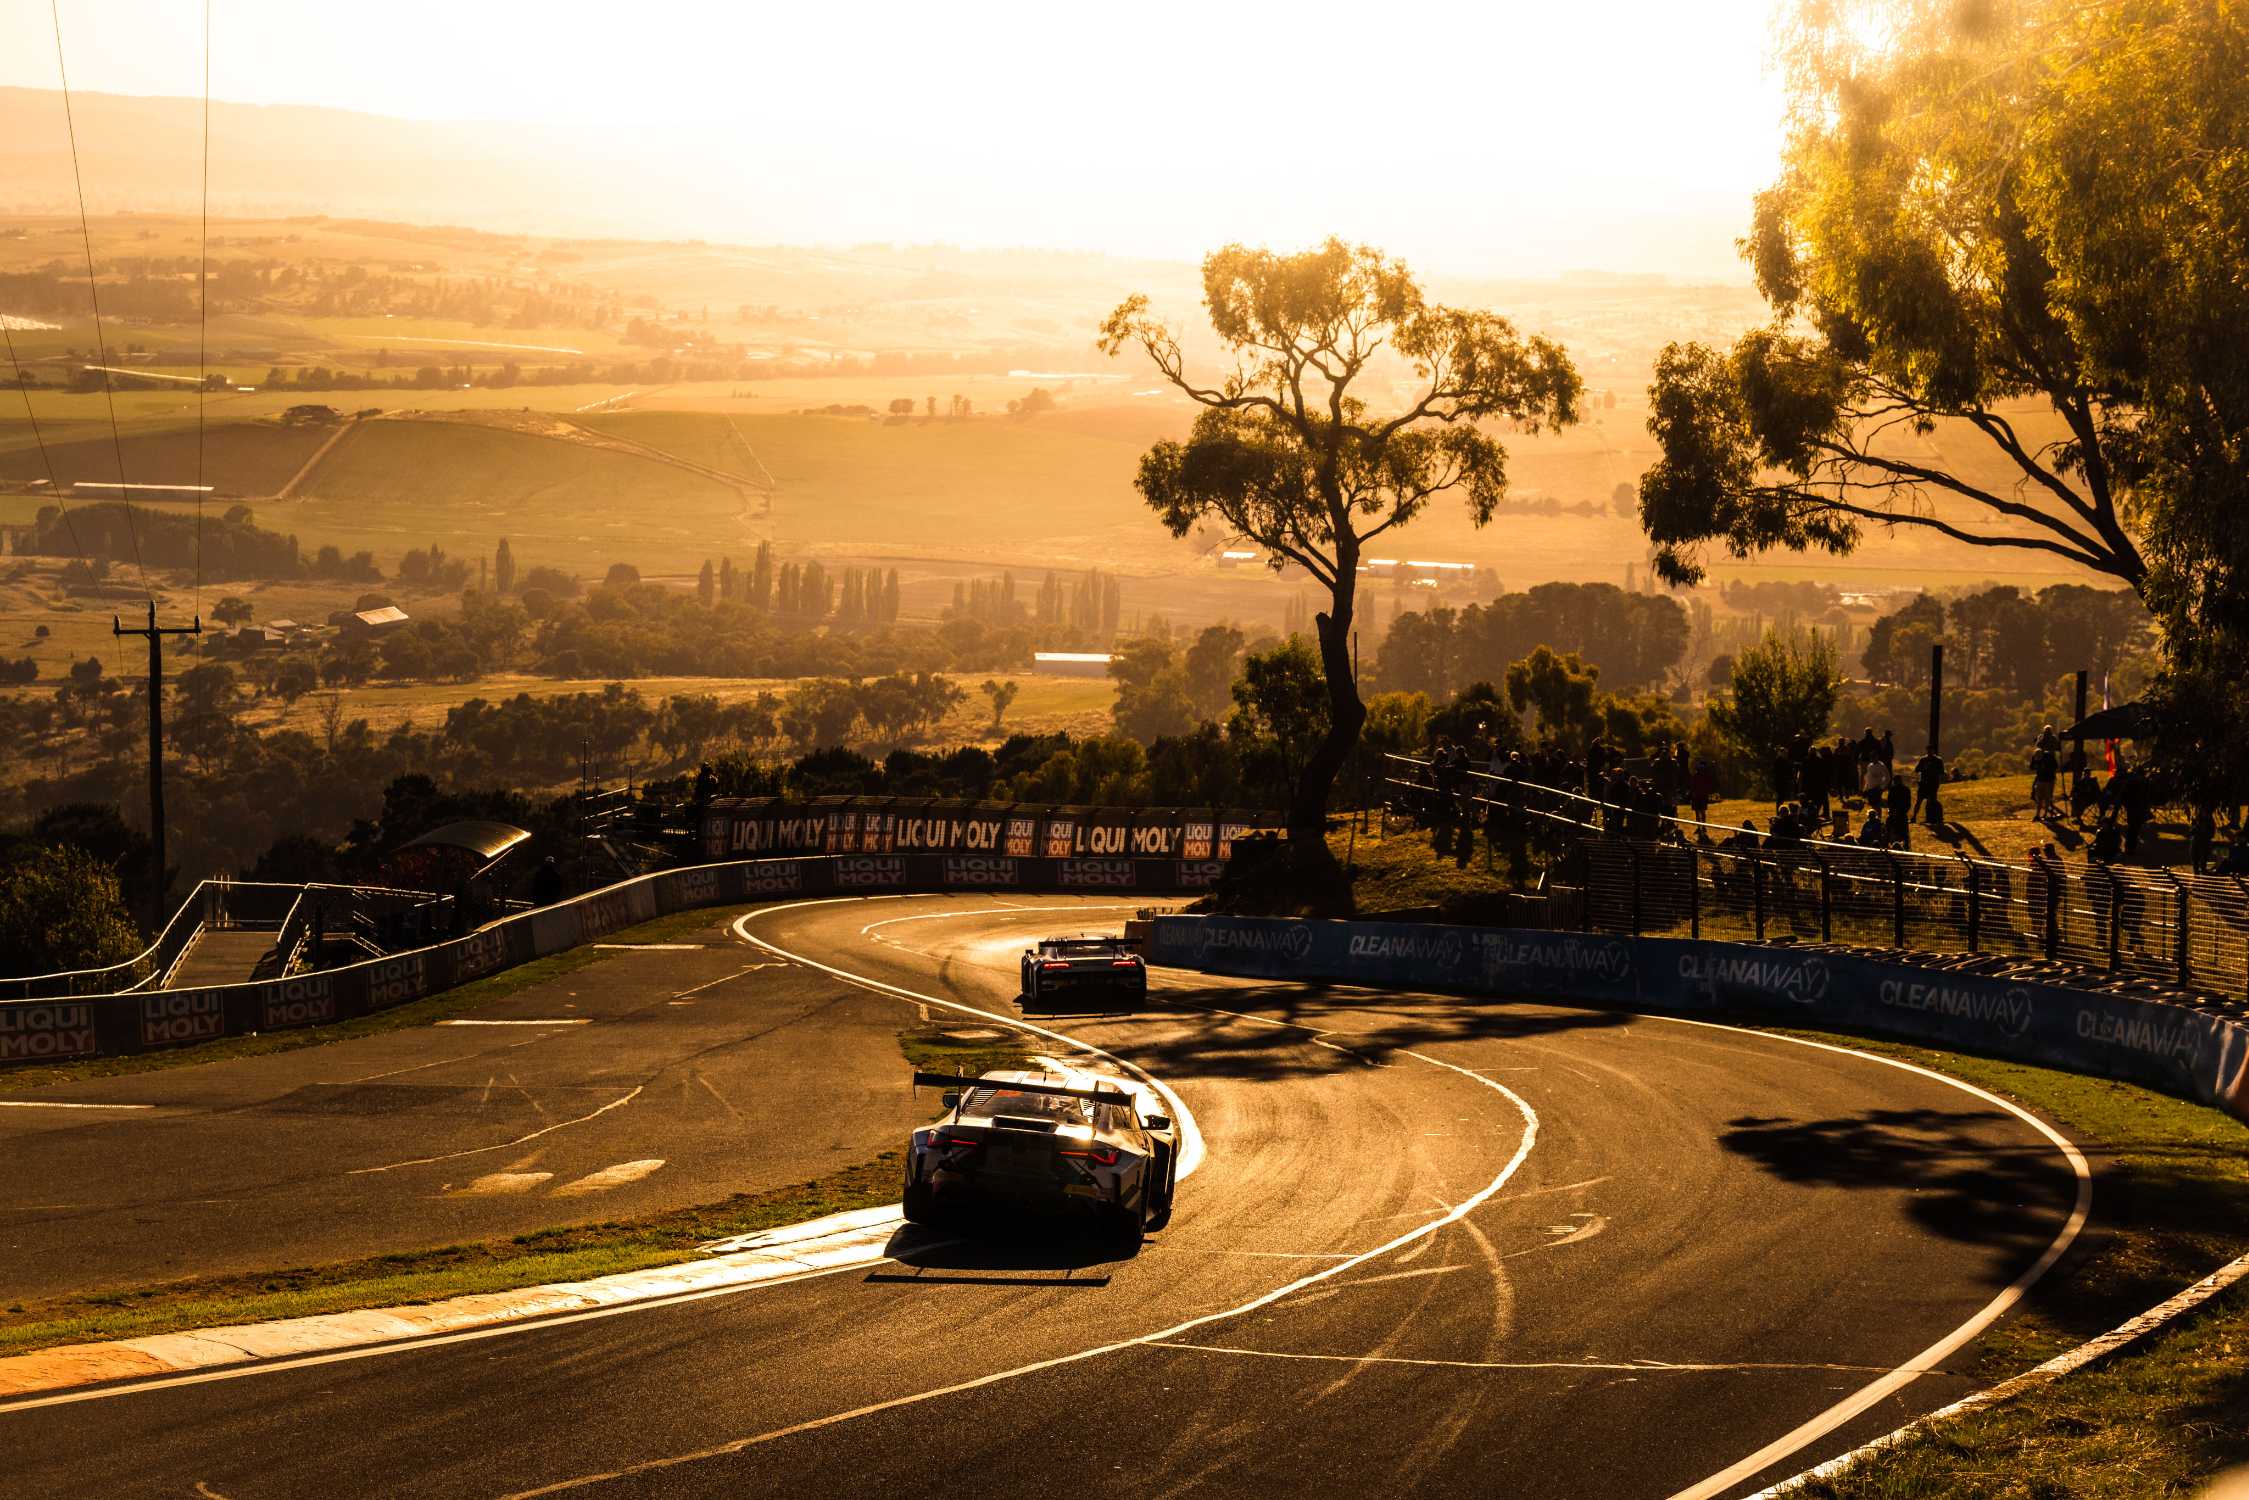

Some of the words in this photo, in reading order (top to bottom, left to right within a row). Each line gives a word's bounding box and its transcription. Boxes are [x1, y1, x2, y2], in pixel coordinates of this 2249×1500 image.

[731, 818, 775, 850] LIQUI
[778, 817, 825, 849] MOLY
[896, 818, 947, 849] LIQUI
[950, 818, 1002, 849] MOLY
[1049, 823, 1073, 838] IQUI
[1131, 826, 1182, 853] MOLY
[1185, 841, 1212, 858] MOLY
[743, 864, 800, 879] LIQUI
[836, 872, 902, 884] MOLY
[837, 859, 902, 872] LIQUI
[946, 871, 1015, 884] MOLY
[947, 859, 1016, 872] LIQUI
[1063, 861, 1131, 873] LIQUI
[1063, 872, 1131, 885] MOLY
[743, 877, 801, 891] MOLY
[1349, 935, 1456, 962] CLEANAWAY
[369, 956, 426, 984] LIQUI
[267, 978, 333, 1004] LIQUI
[370, 974, 426, 1004] MOLY
[1880, 979, 2024, 1025] CLEANAWAY
[145, 990, 219, 1018] LIQUI
[267, 999, 333, 1024] MOLY
[0, 1006, 89, 1032] LIQUI
[145, 1012, 222, 1040] MOLY
[0, 1030, 90, 1057] MOLY
